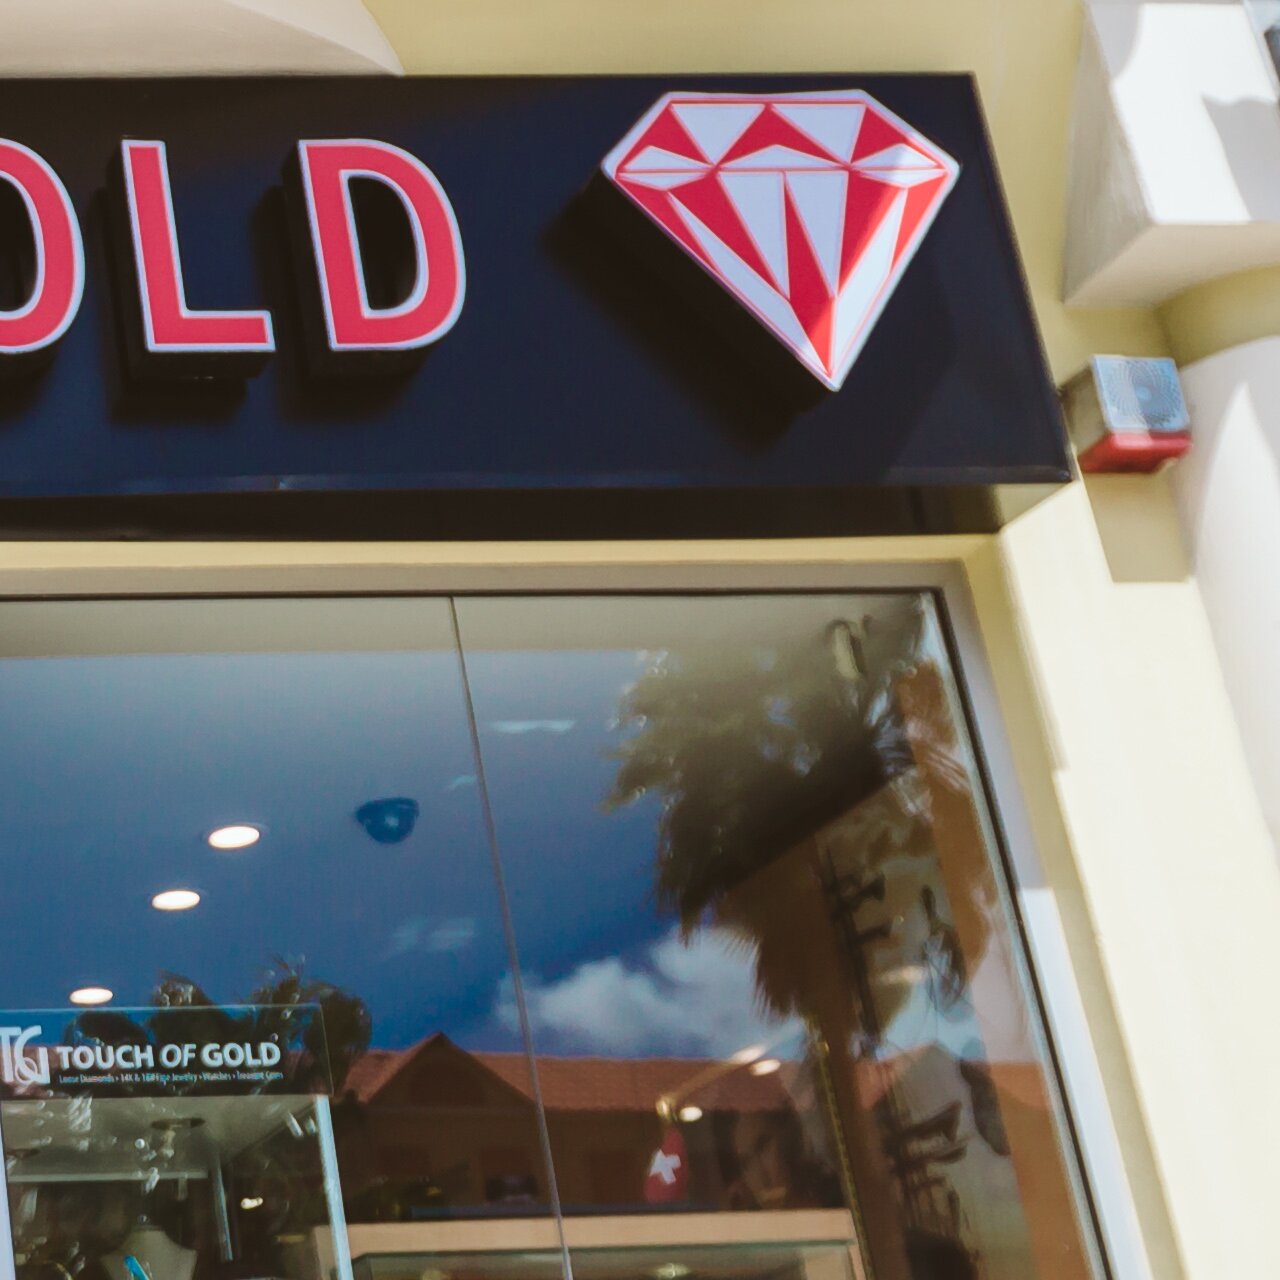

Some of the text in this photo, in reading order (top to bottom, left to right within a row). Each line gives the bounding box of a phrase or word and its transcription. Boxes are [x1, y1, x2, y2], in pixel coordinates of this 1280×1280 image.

[56, 1042, 281, 1070] TOUCH OF GOLD
